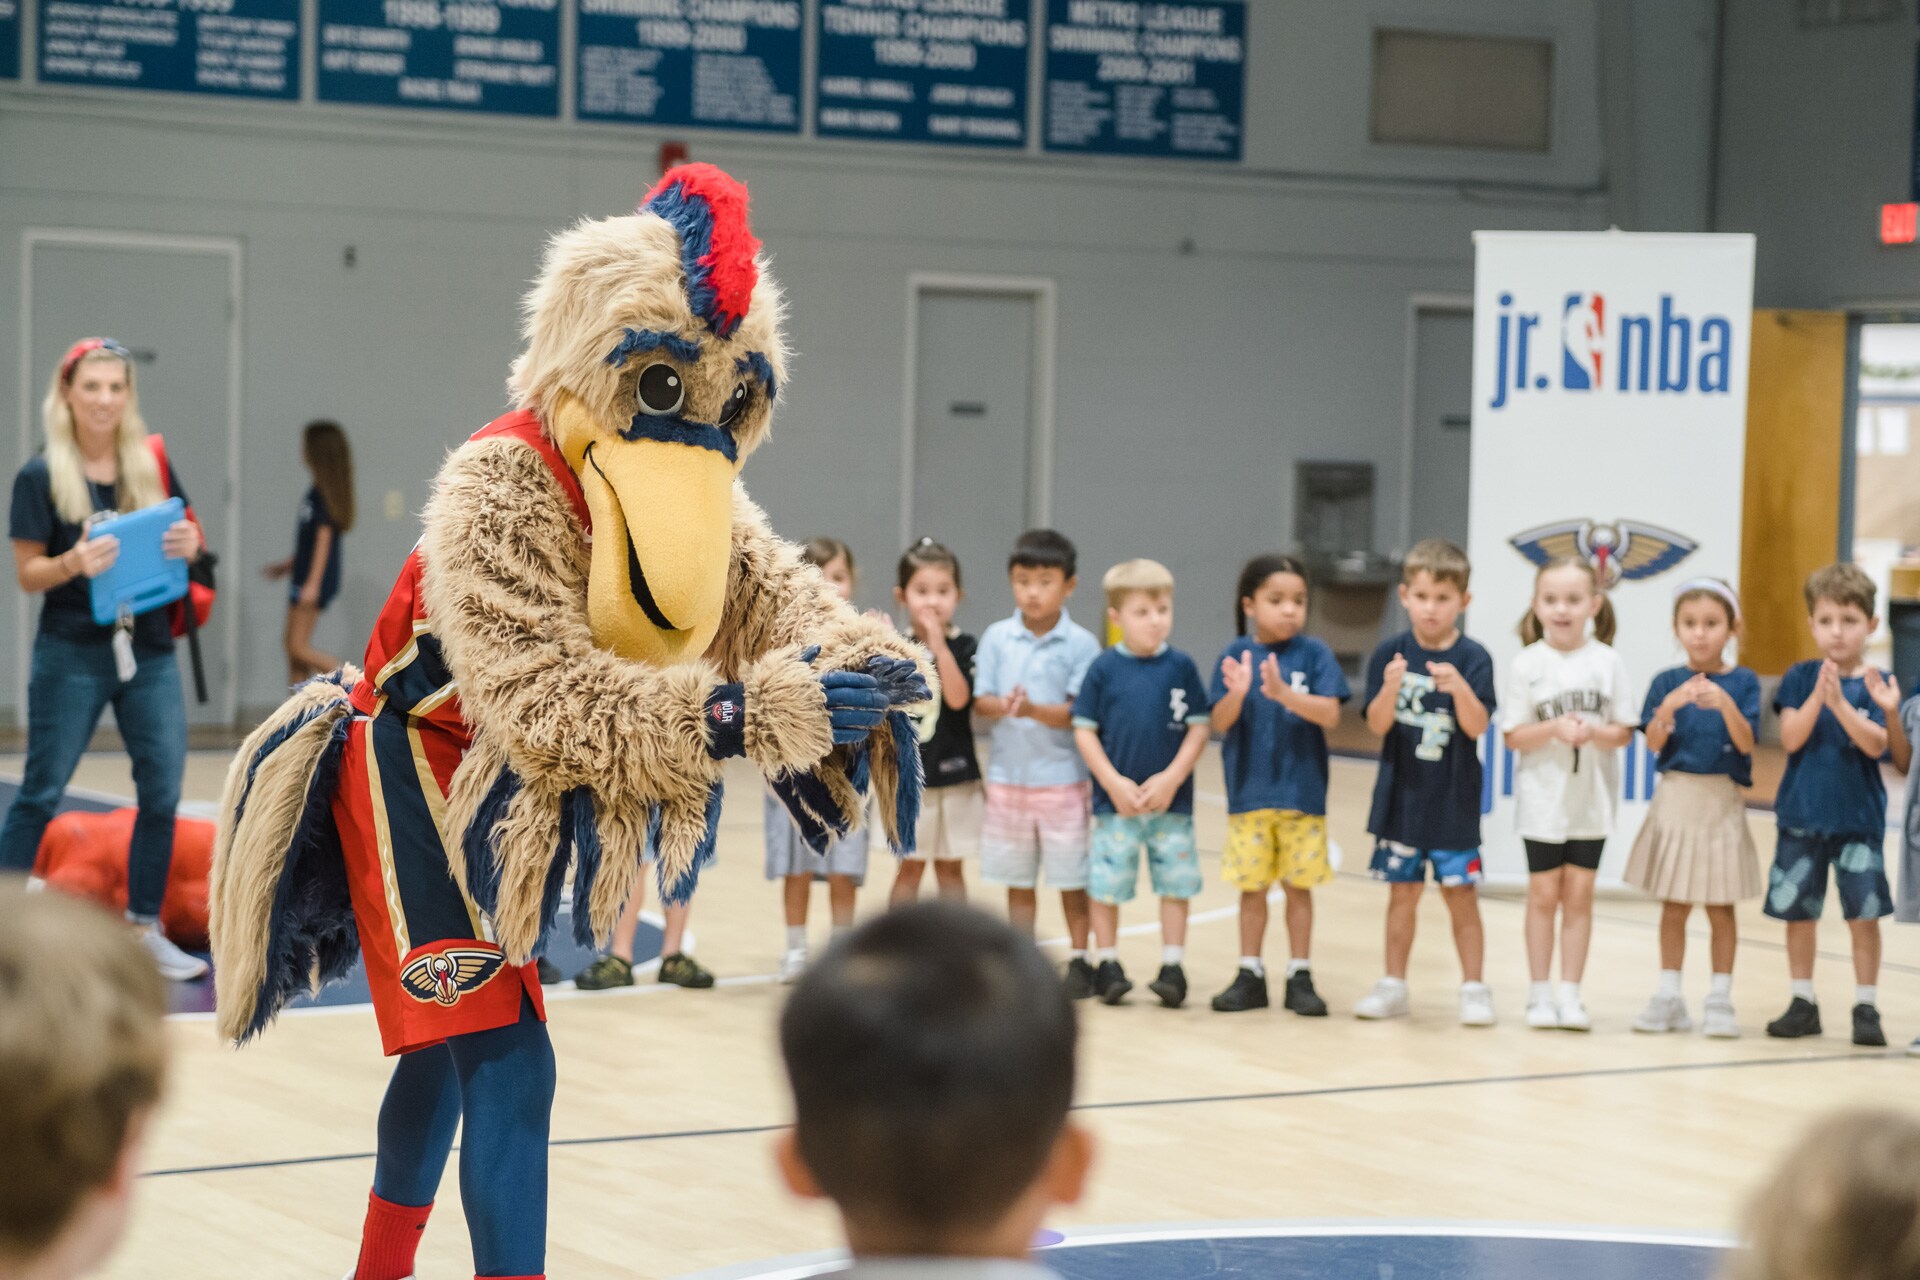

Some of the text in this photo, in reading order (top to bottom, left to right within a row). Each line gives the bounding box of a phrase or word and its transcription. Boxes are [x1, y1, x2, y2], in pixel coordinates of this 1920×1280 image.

[823, 6, 1026, 46] TENNIS CHAMPIONS
[1067, 2, 1223, 32] METRO LEAGUE
[1142, 32, 1241, 62] CHAMPIONS
[1489, 293, 1732, 409] jr. nba
[720, 700, 734, 722] NOLA
